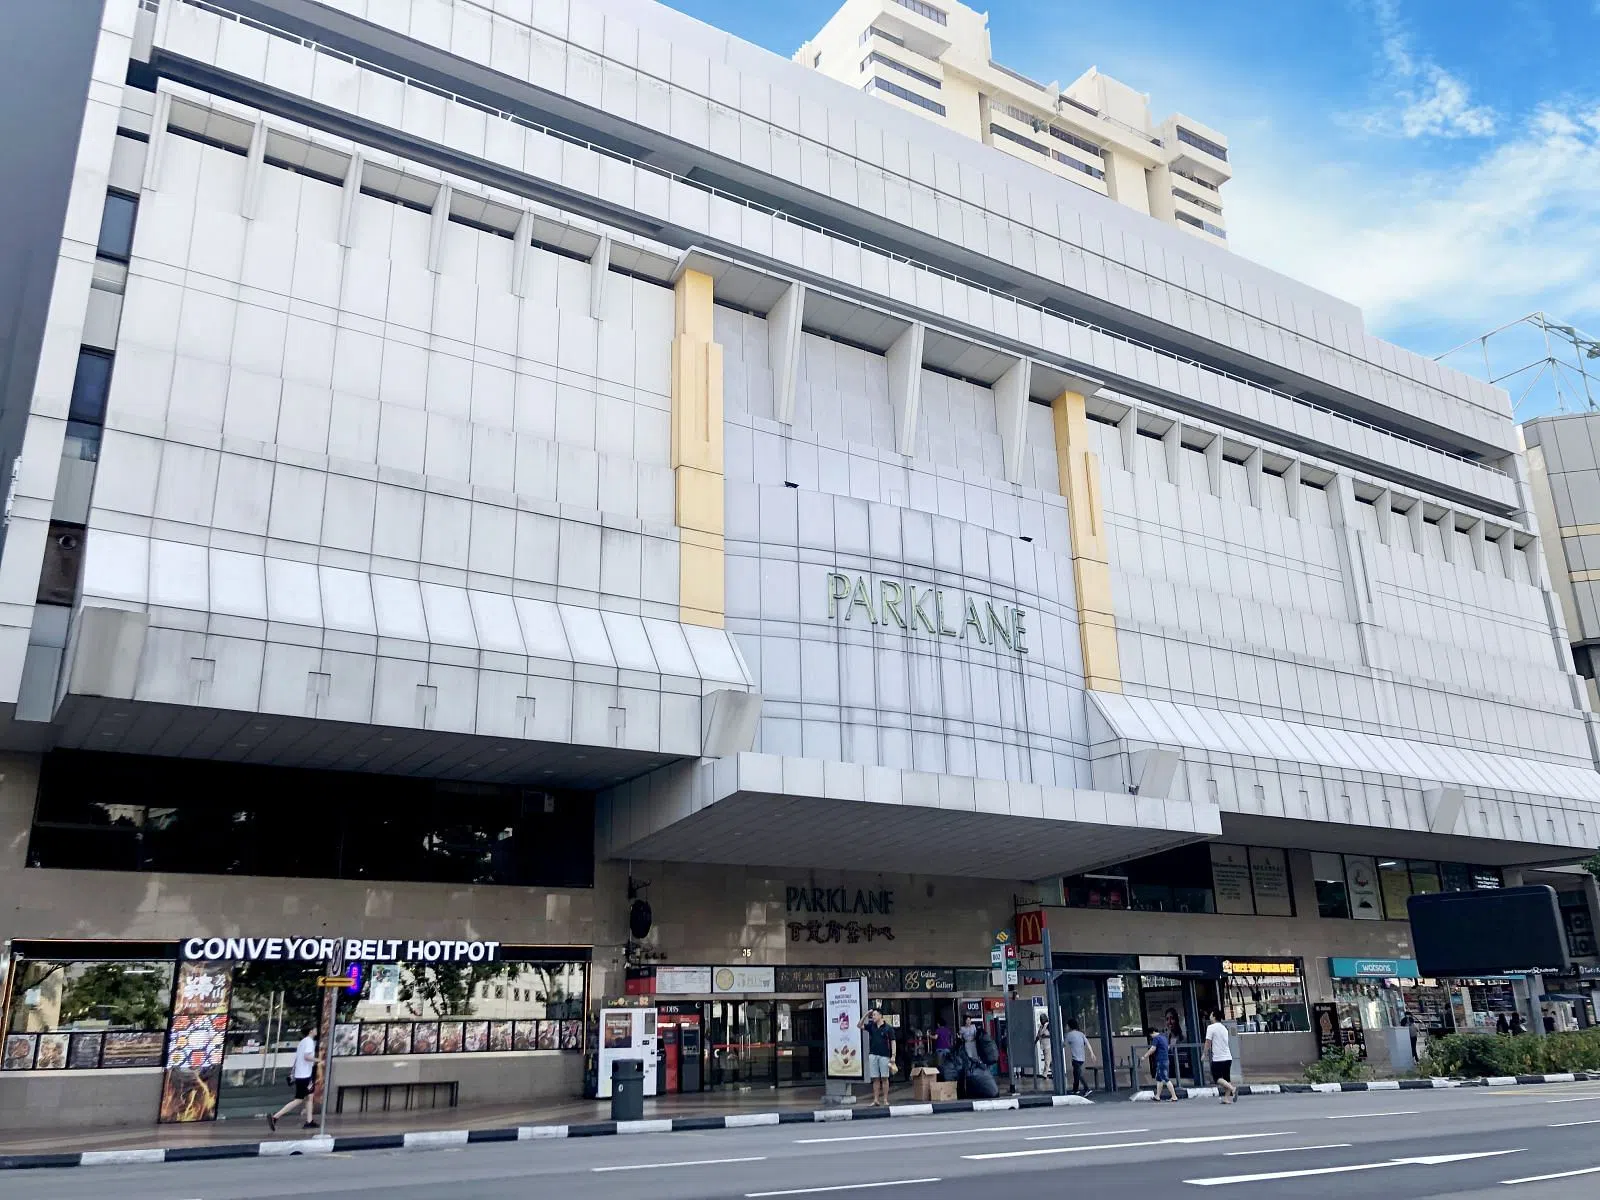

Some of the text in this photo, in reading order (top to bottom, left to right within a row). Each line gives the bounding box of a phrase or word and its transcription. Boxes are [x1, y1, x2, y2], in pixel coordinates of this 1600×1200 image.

[827, 572, 1029, 654] PARKLANE
[786, 886, 894, 915] PARKLANE
[184, 937, 500, 962] CONVEYOR BELT HOTPOT
[742, 948, 752, 957] 35
[1361, 963, 1392, 973] watsons
[920, 970, 937, 978] Guitar
[935, 981, 954, 991] Gallery
[666, 1005, 679, 1013] DBS
[967, 1002, 979, 1010] UOB
